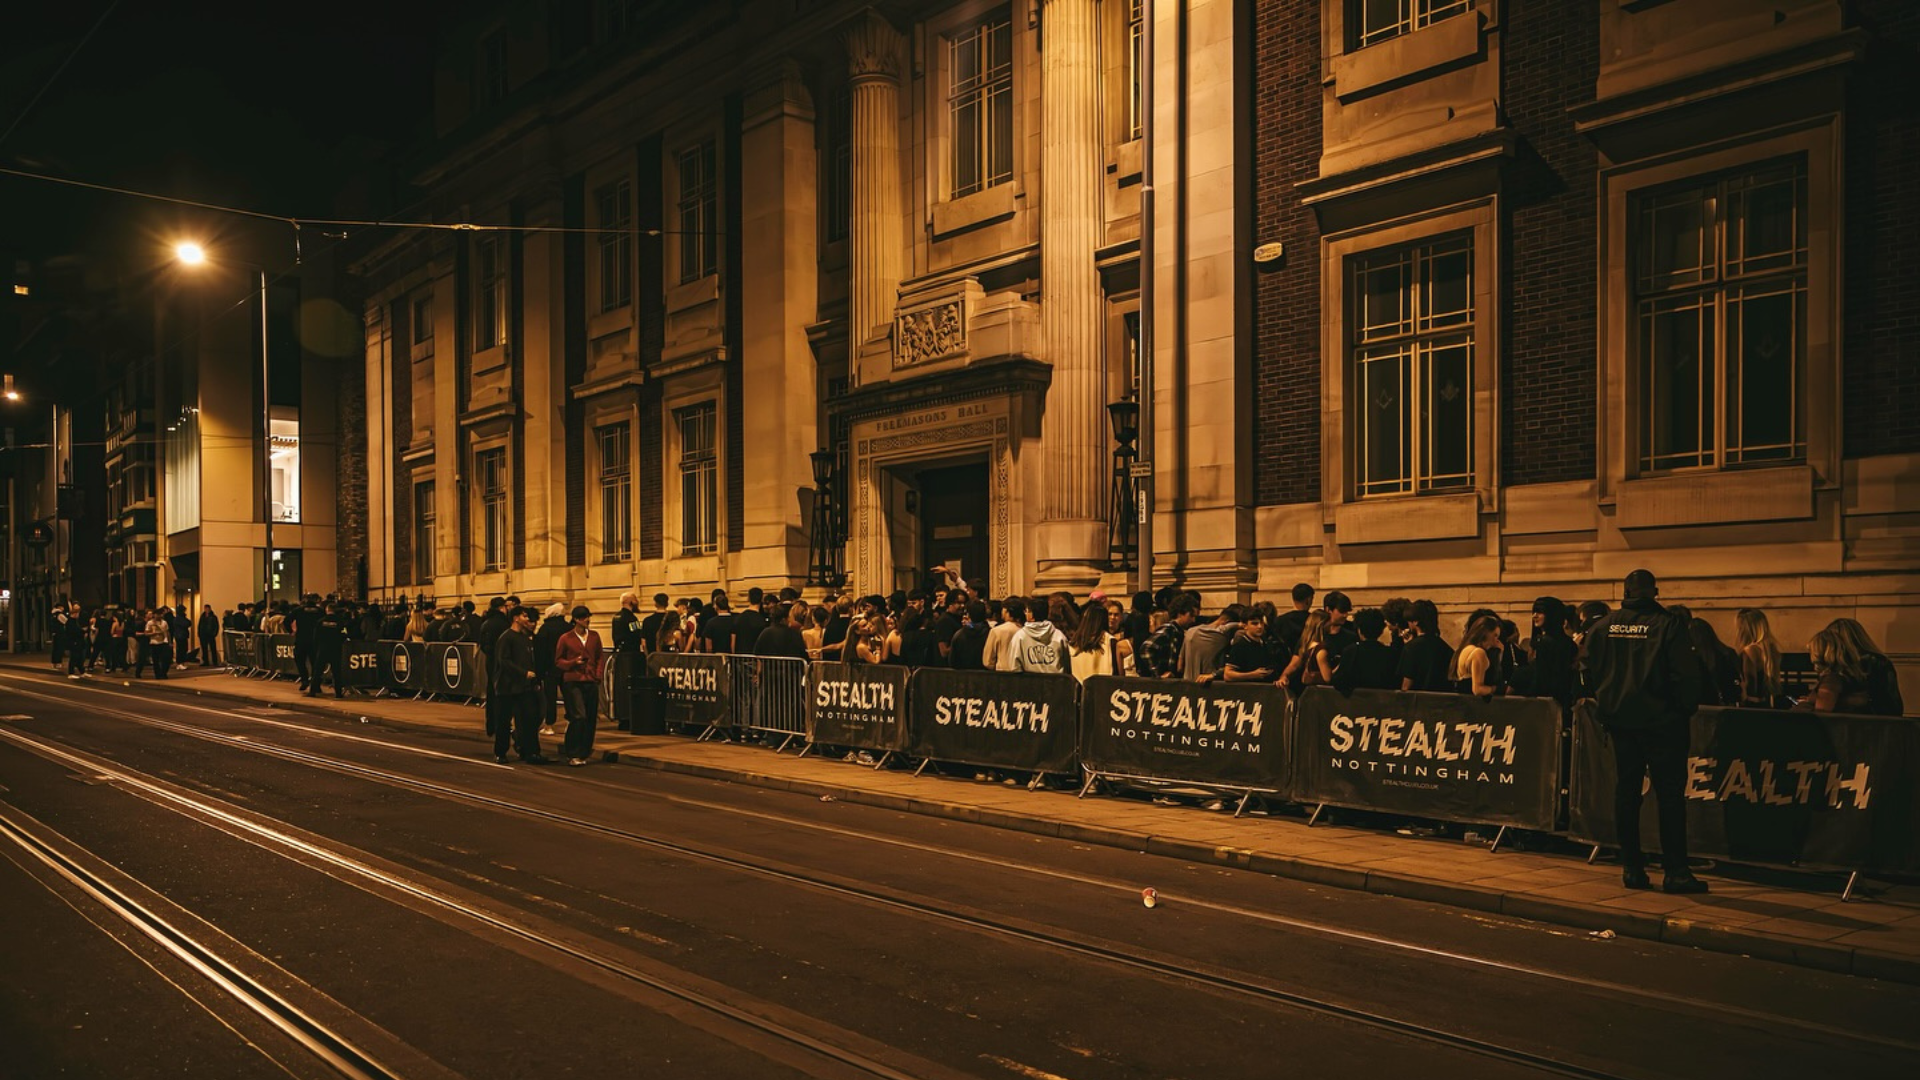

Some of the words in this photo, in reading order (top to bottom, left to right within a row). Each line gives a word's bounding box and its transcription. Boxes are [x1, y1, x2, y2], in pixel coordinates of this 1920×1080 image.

[876, 411, 947, 432] FREEMASONS
[958, 404, 988, 419] HALL
[1609, 624, 1649, 634] SECURITY
[816, 681, 894, 711] STEALTH
[816, 711, 895, 724] NOTTINGHAM
[935, 696, 1050, 733] STEALTH
[1110, 689, 1263, 737] STEALTH
[1111, 727, 1261, 754] NOTTINGHAM
[1330, 713, 1517, 766] STEALTH
[1331, 757, 1515, 785] NOTTINGHAM
[1641, 757, 1871, 810] EALTH
